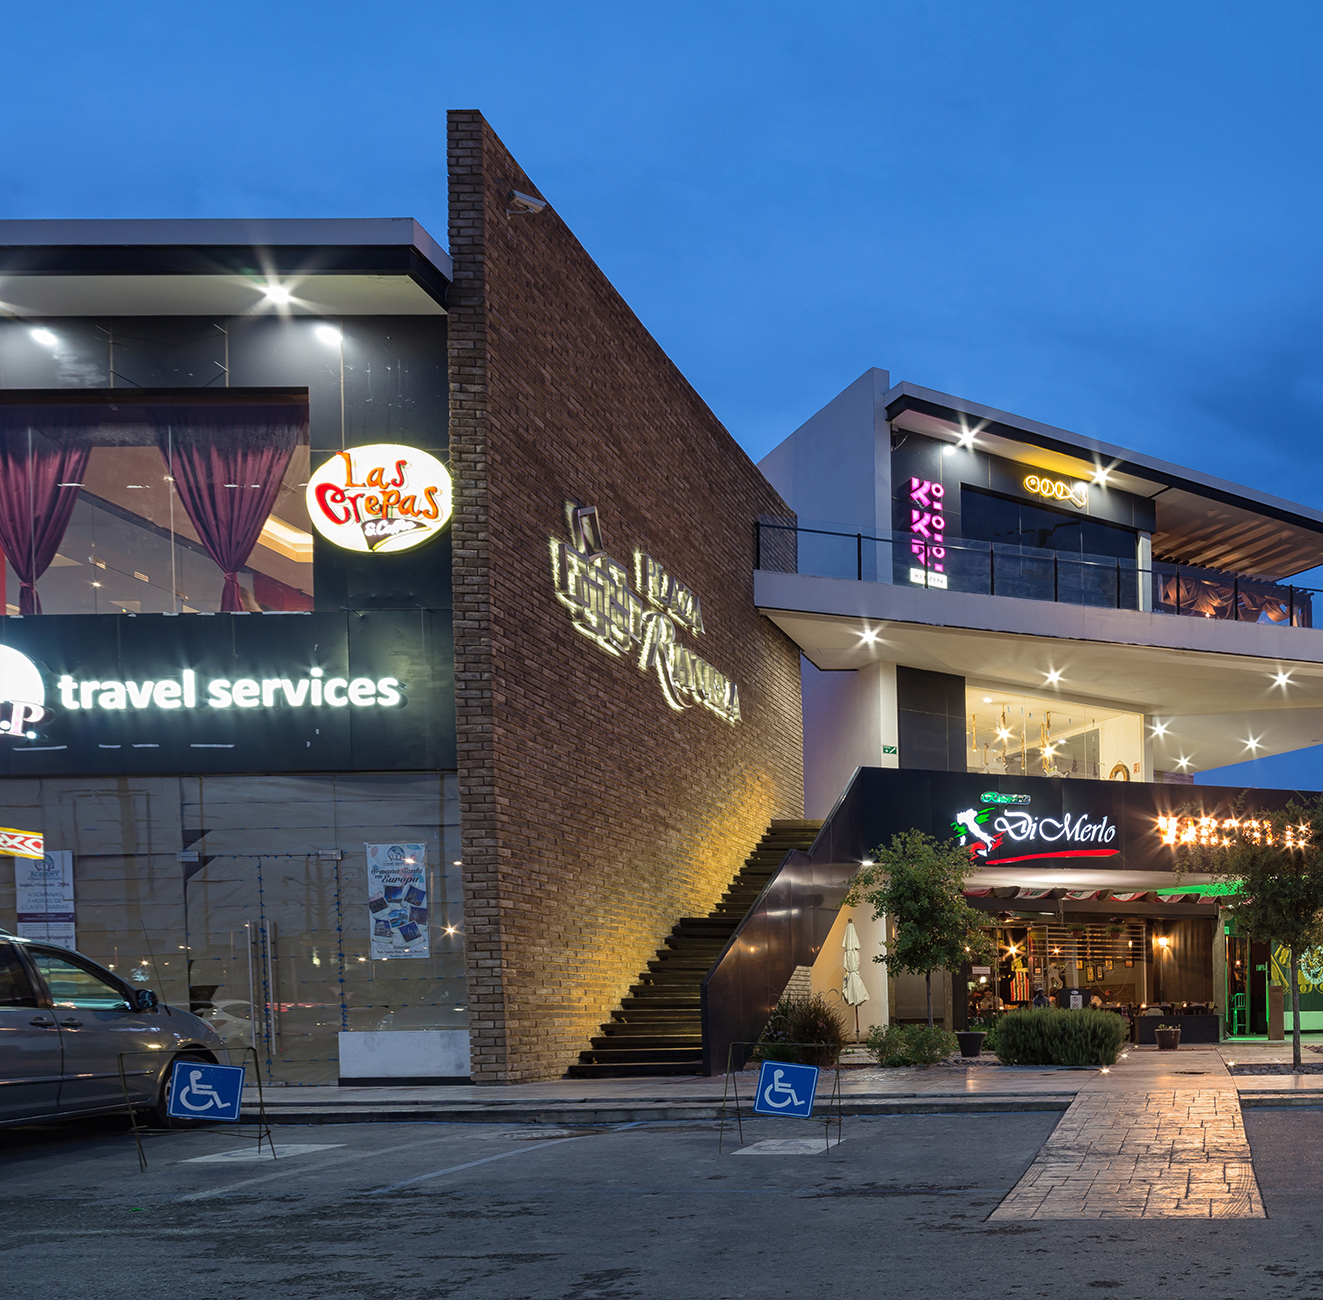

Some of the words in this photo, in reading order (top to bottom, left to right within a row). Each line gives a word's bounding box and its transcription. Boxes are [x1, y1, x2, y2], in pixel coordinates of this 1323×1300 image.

[336, 451, 407, 489] Las
[314, 482, 439, 526] Crepas
[635, 550, 706, 634] PLAZA
[914, 573, 944, 584] KIZEN
[57, 668, 196, 710] travel
[207, 667, 401, 708] services
[382, 875, 419, 885] Europa
